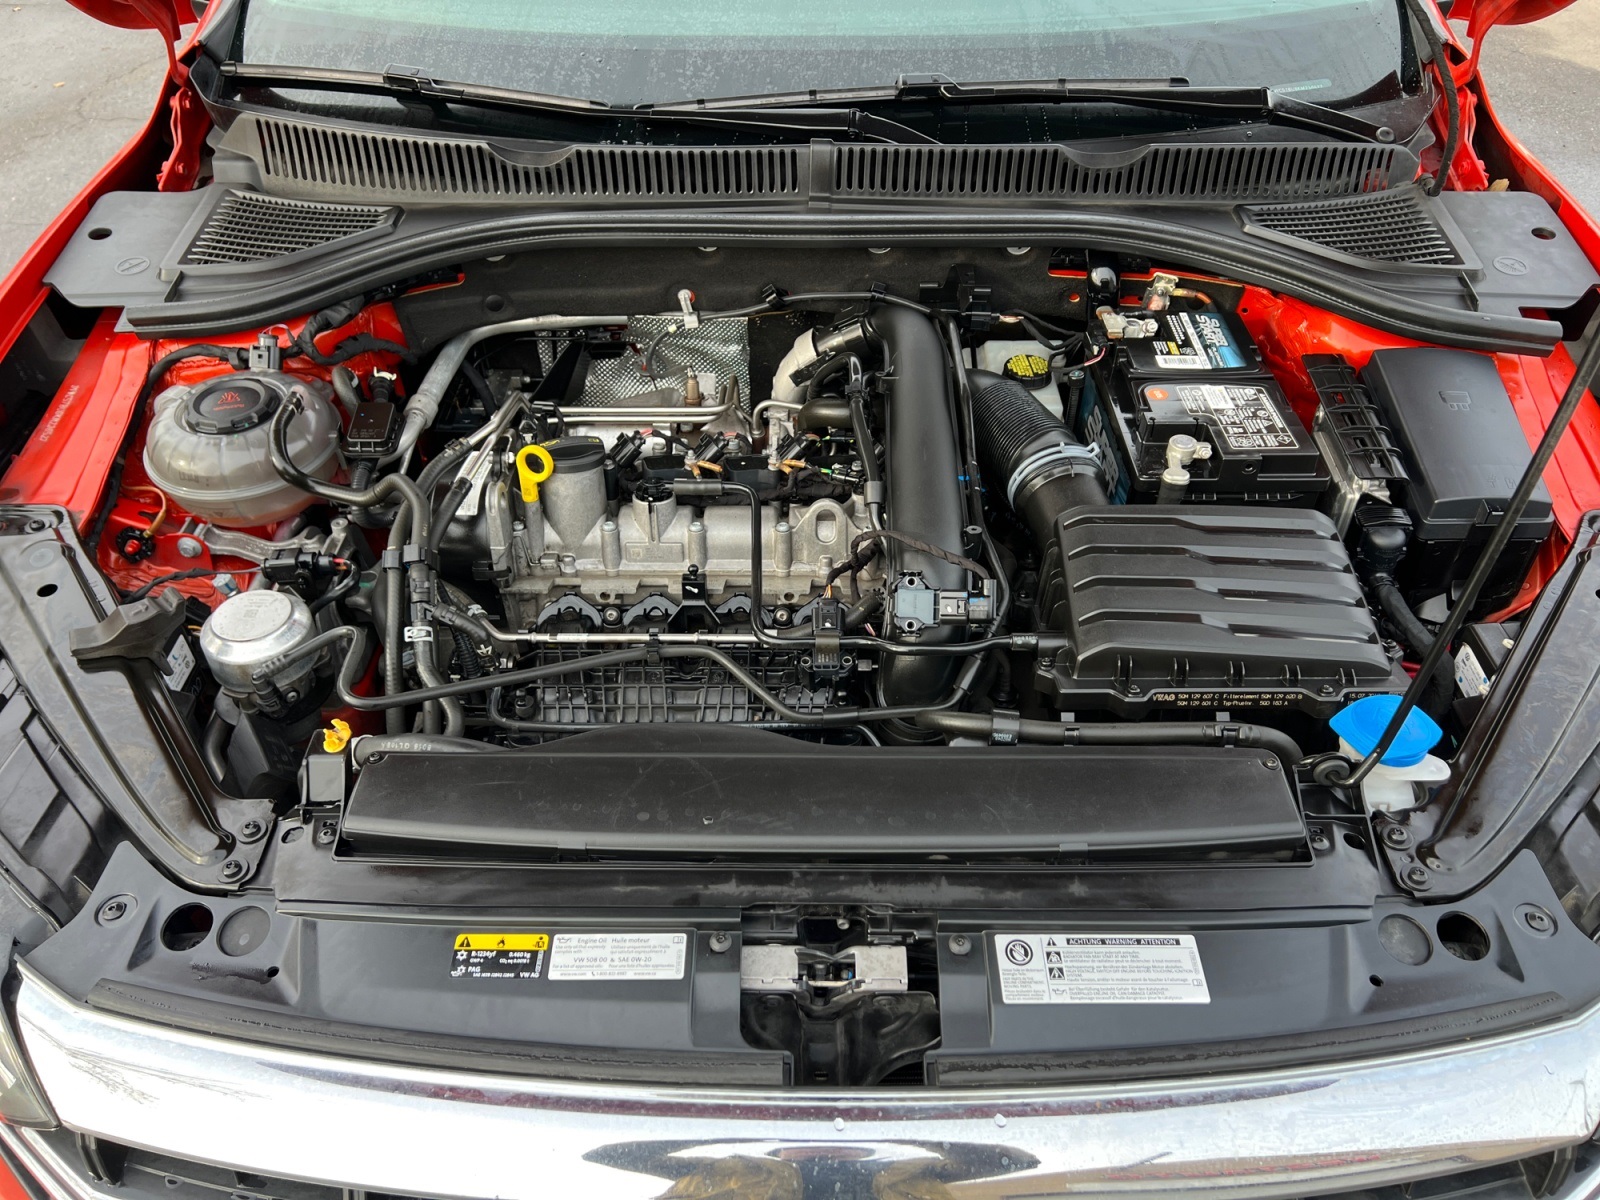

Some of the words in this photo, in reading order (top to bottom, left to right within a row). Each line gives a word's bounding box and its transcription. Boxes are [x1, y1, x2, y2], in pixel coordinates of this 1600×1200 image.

[1195, 314, 1217, 346] START
[471, 950, 497, 959] R-1234yf
[524, 951, 531, 959] kg
